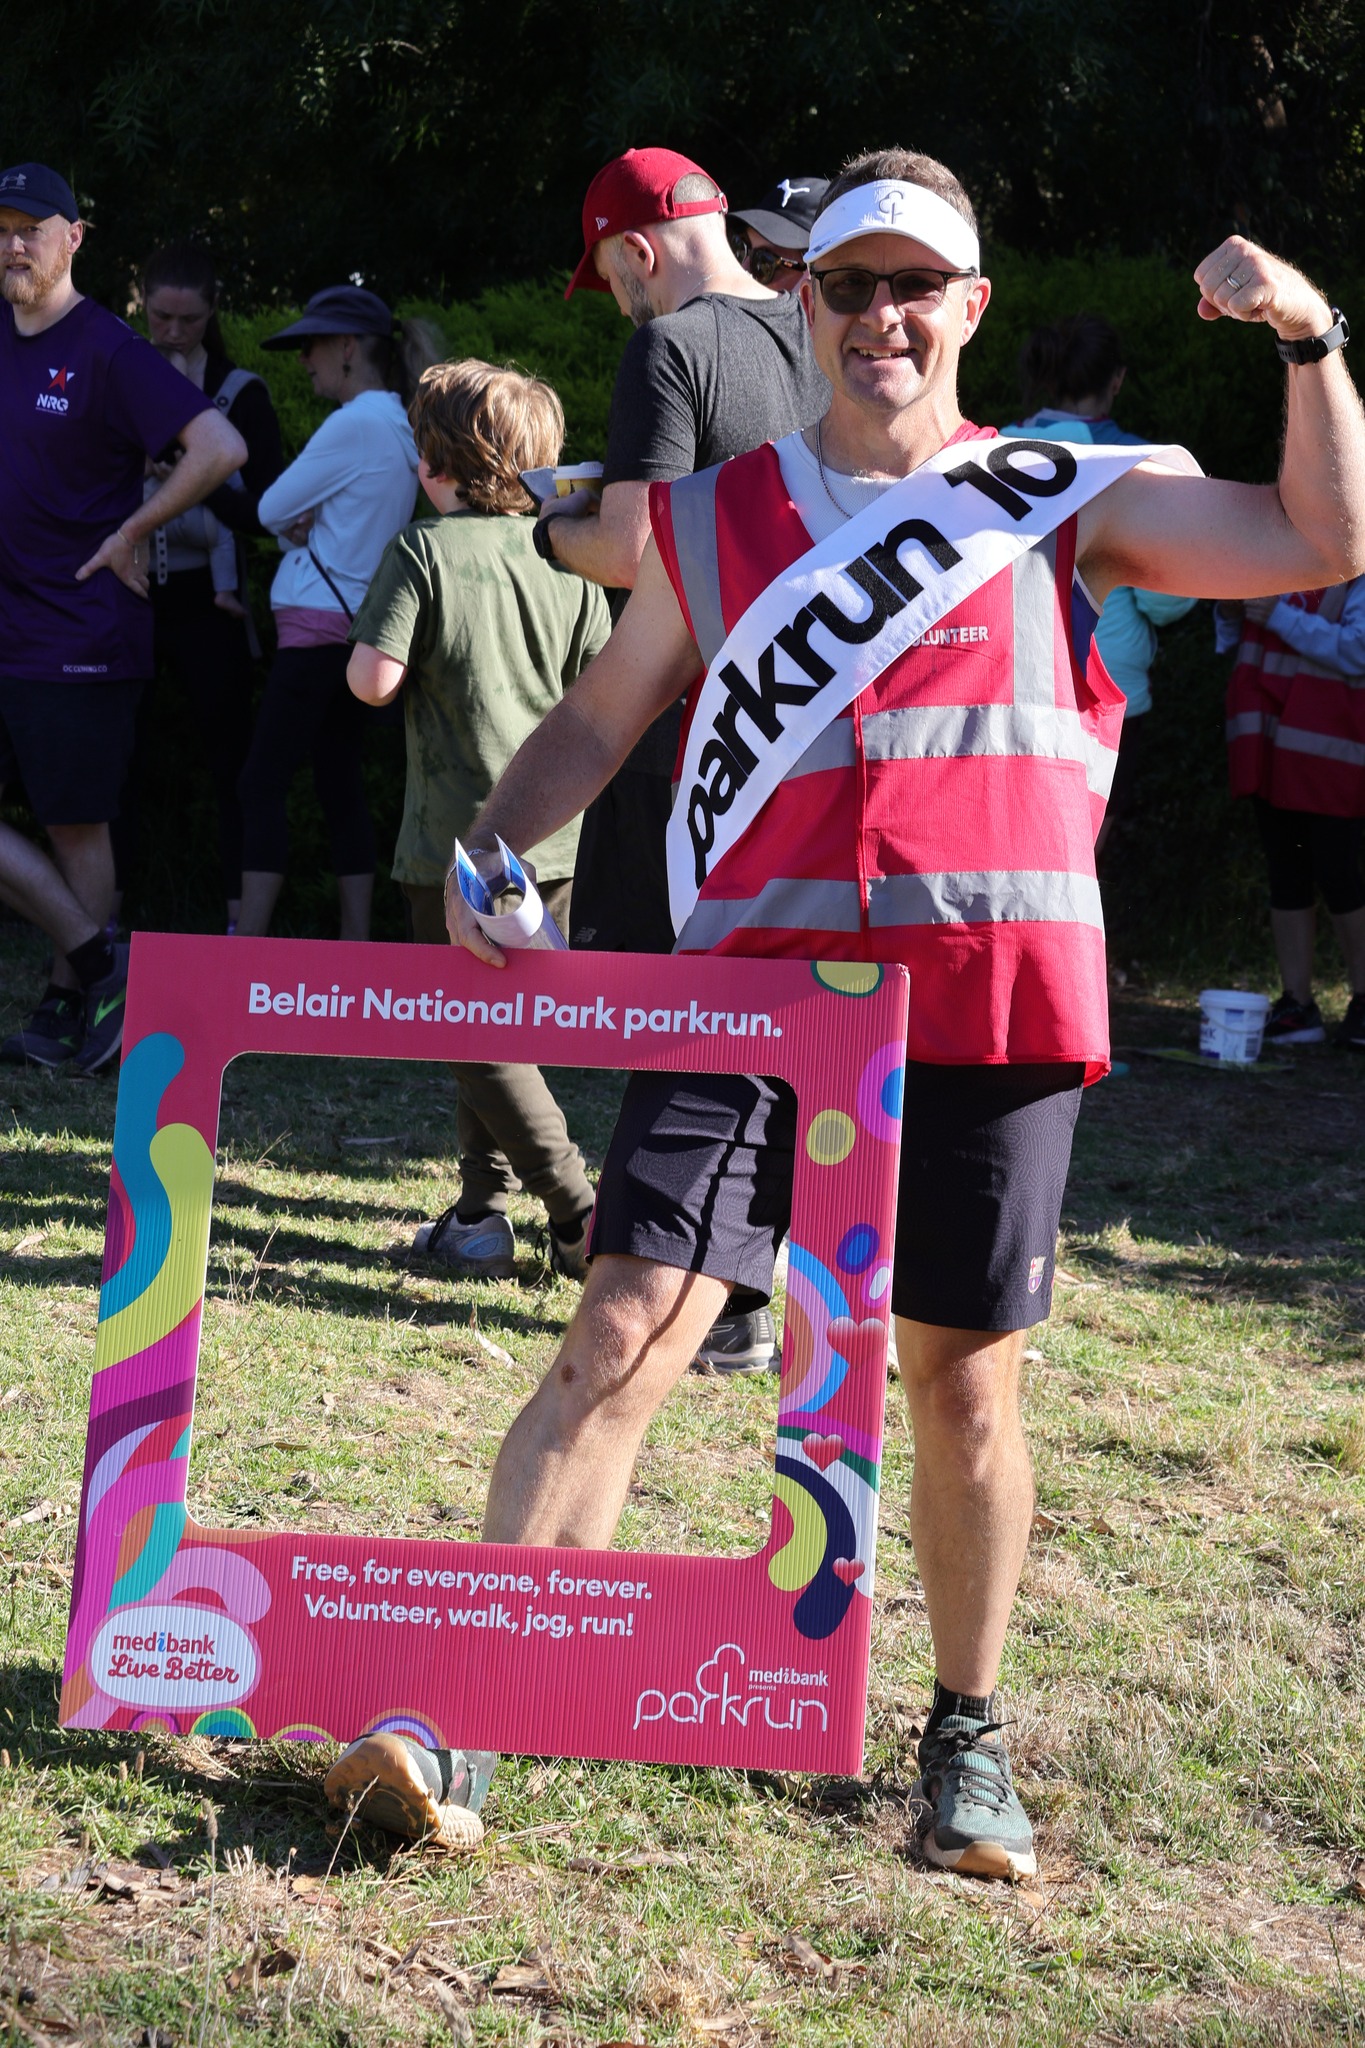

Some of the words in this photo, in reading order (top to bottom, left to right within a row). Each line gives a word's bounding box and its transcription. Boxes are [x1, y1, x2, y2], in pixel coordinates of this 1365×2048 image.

[37, 393, 69, 412] NRG
[912, 625, 990, 647] LUNTEER
[687, 518, 963, 889] parkrun
[943, 440, 1078, 522] 10
[249, 982, 356, 1018] Belair
[363, 987, 524, 1026] National
[533, 995, 617, 1030] Park
[623, 1000, 783, 1040] parkrun.
[291, 1555, 357, 1587] Free,
[362, 1559, 403, 1585] for
[406, 1568, 541, 1598] everyone,
[546, 1569, 653, 1601] forever.
[304, 1593, 442, 1630] Volunteer,
[448, 1603, 519, 1634] walk,
[521, 1605, 575, 1639] jog,
[580, 1612, 635, 1637] run!
[112, 1631, 216, 1655] medibank
[107, 1654, 160, 1678] Live
[163, 1656, 240, 1684] Better
[748, 1667, 829, 1687] medibank
[632, 1668, 829, 1732] parkrun
[748, 1684, 777, 1692] presents
